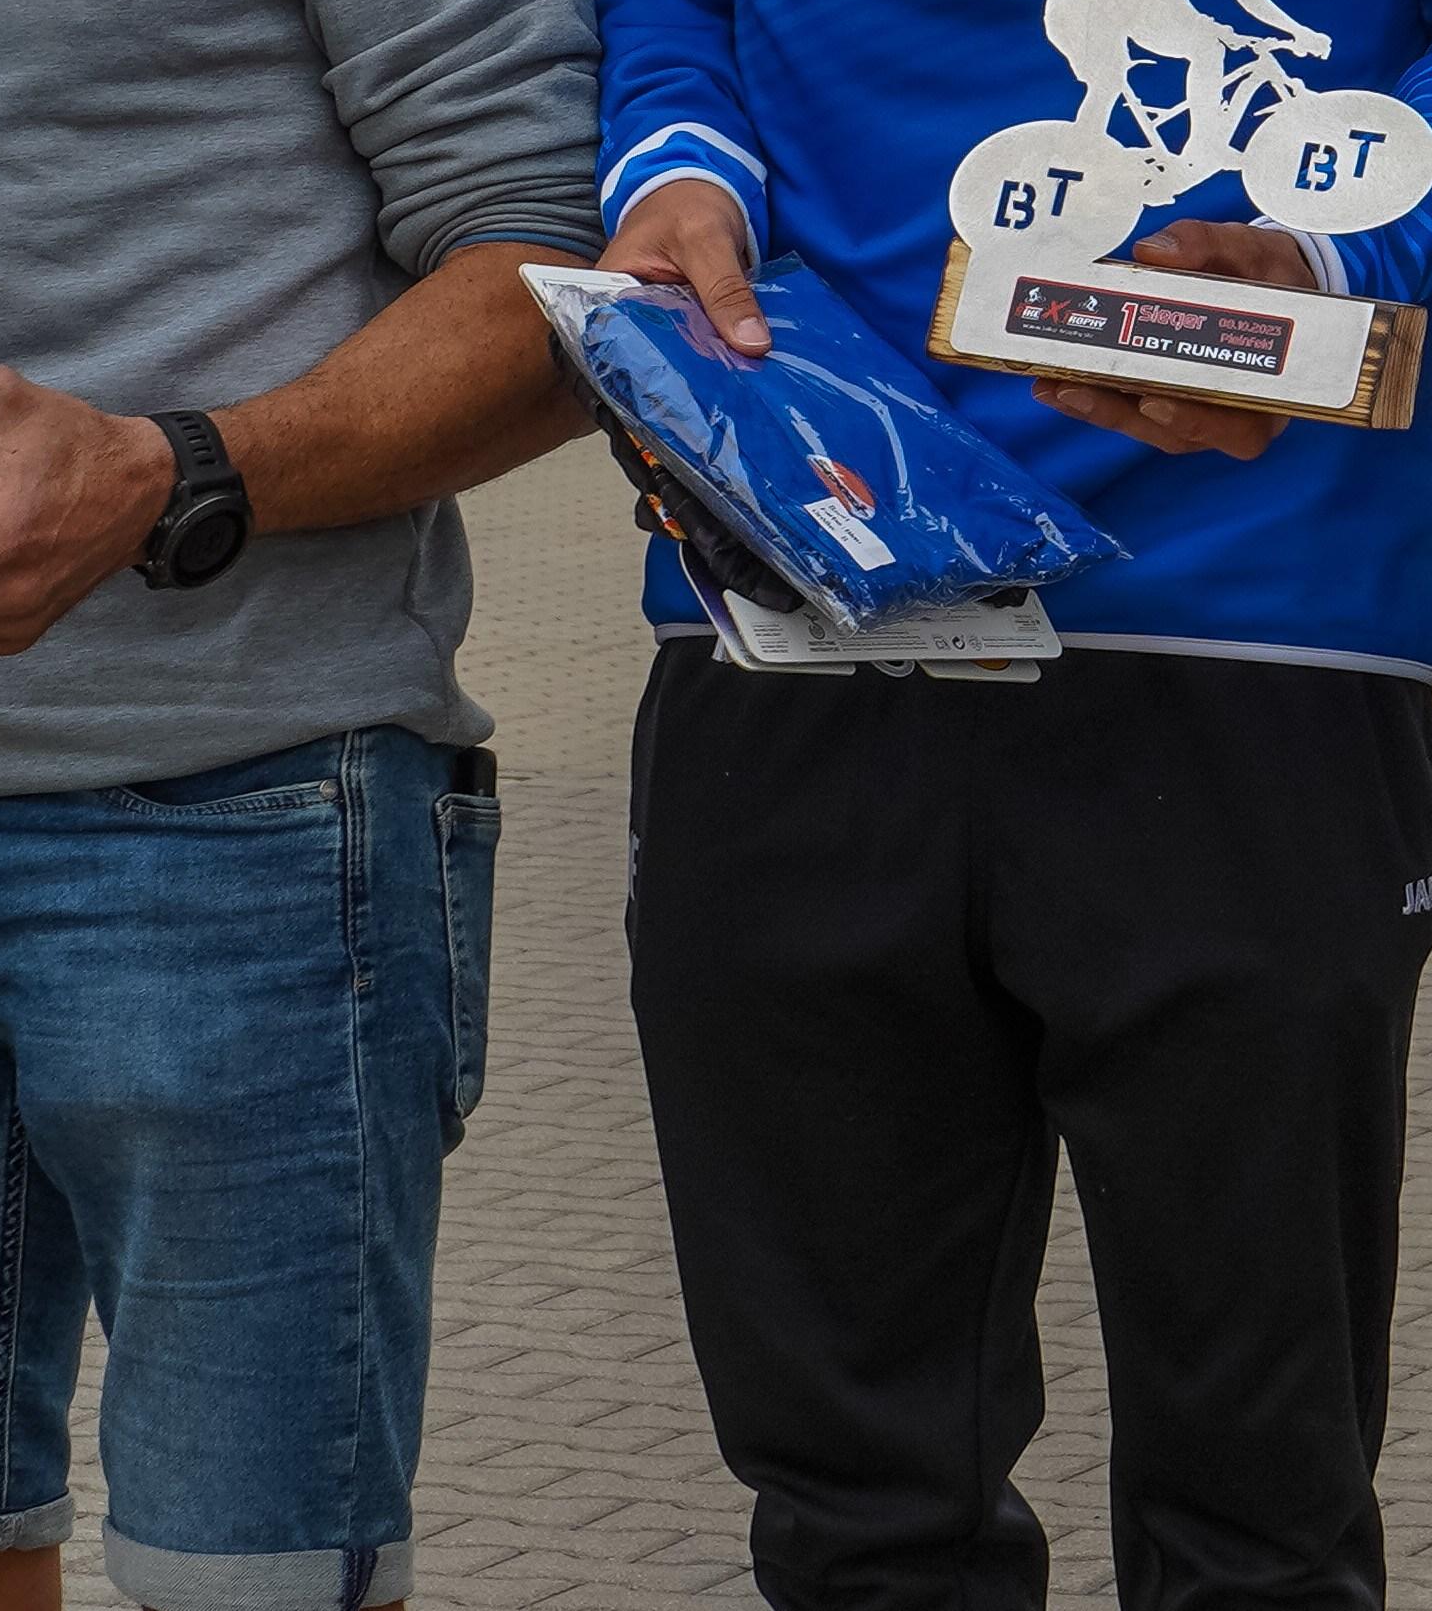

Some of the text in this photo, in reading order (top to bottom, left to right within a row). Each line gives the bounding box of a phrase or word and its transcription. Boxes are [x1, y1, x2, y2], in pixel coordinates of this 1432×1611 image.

[1294, 129, 1386, 192] BT
[993, 167, 1085, 230] BT
[1137, 303, 1208, 331] Sieger
[1145, 336, 1278, 369] BT RUN&BIKE
